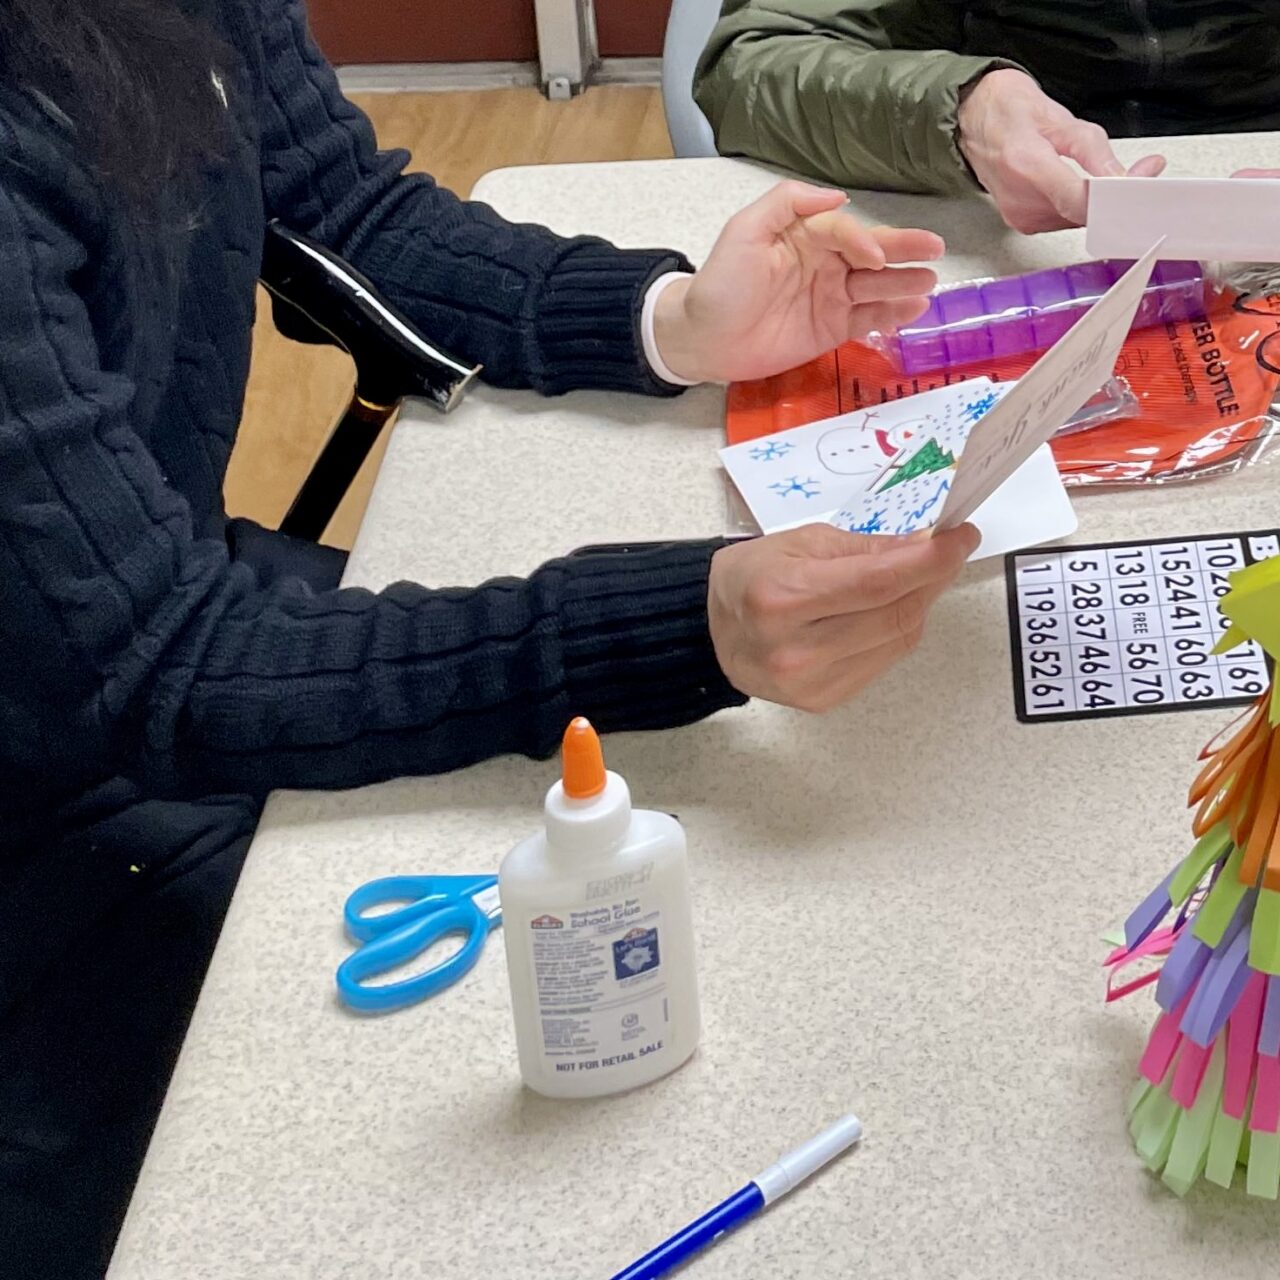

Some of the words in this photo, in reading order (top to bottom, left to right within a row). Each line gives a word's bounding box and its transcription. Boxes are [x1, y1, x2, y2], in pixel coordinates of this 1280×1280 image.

[1201, 348, 1240, 417] BOTTLE
[1023, 565, 1051, 573] 1
[1069, 561, 1098, 572] 5
[1114, 551, 1145, 576] 13
[1160, 547, 1191, 571] 15
[1024, 587, 1056, 612] 19
[1071, 582, 1103, 610] 28
[1118, 580, 1150, 606] 18
[1164, 575, 1197, 602] 24
[1026, 617, 1059, 645] 36
[1074, 614, 1107, 640] 37
[1132, 612, 1148, 634] FREE
[1170, 606, 1202, 630] 41
[1205, 543, 1237, 568] 10
[1228, 667, 1263, 694] 69
[1029, 650, 1062, 679] 52
[1078, 645, 1111, 674] 46
[1126, 642, 1159, 670] 56
[1174, 638, 1208, 666] 60
[1031, 683, 1065, 709] 61
[1081, 679, 1118, 711] 64
[1131, 674, 1166, 706] 70
[1179, 671, 1216, 702] 63
[571, 911, 610, 928] School
[614, 906, 641, 920] Glue
[556, 1062, 575, 1071] NOT
[579, 1061, 599, 1070] FOR
[602, 1053, 636, 1067] RETAIL
[639, 1040, 663, 1057] SALE
